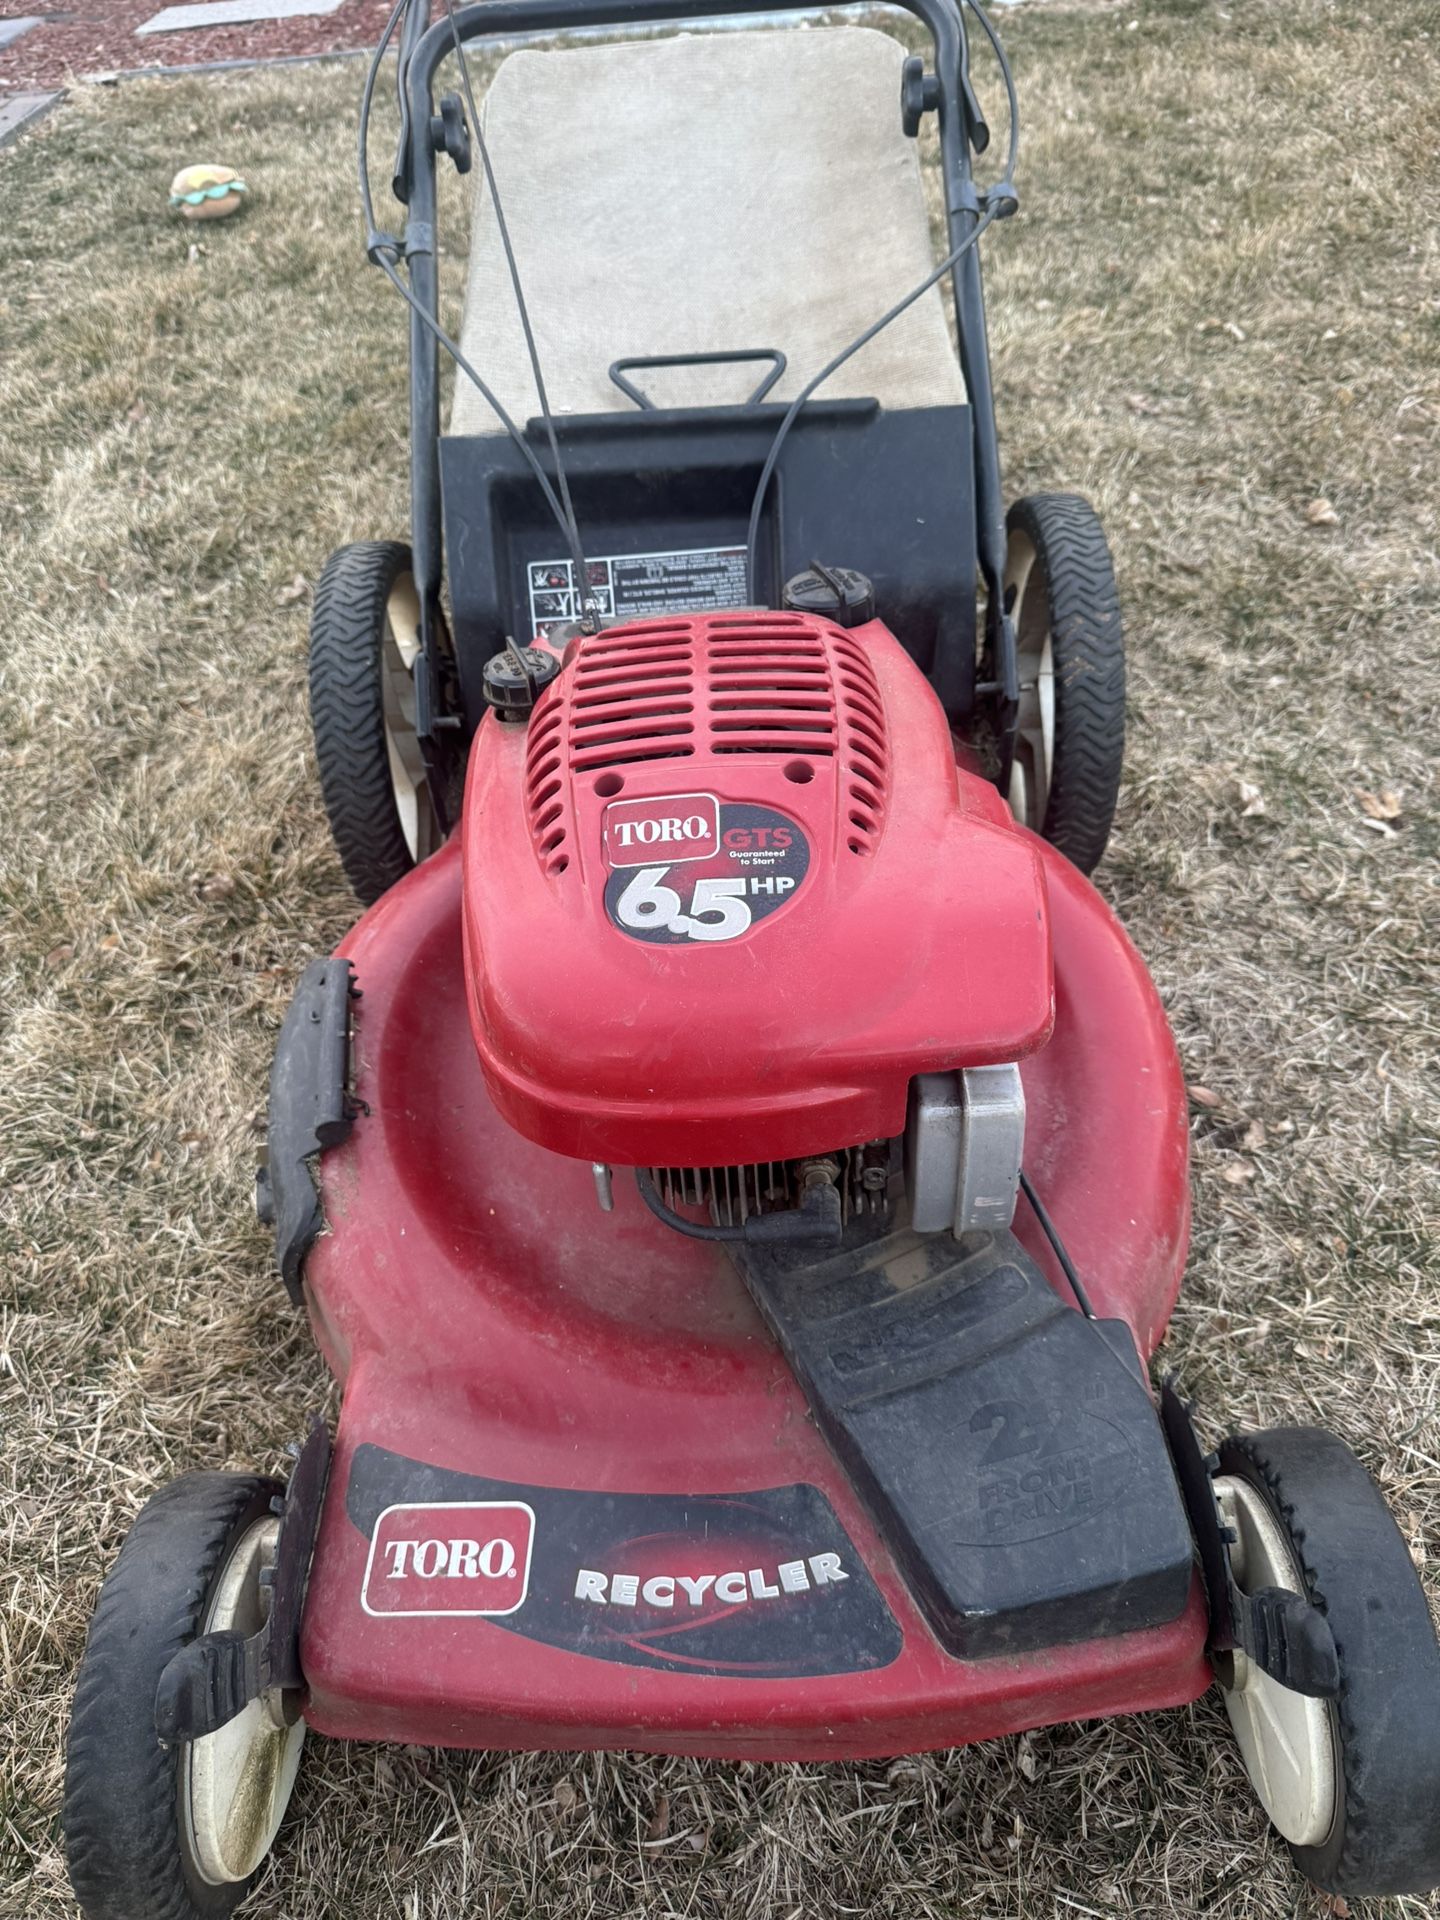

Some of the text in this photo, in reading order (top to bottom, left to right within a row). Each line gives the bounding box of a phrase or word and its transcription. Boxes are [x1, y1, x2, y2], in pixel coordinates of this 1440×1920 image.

[722, 827, 793, 849] GTS
[729, 849, 786, 858] Guaranteed
[752, 857, 775, 865] Start
[617, 866, 796, 941] 6.5 HP
[977, 1455, 1093, 1510] FRONT
[985, 1480, 1094, 1534] DRIVE
[573, 1551, 851, 1608] RECYCLER
